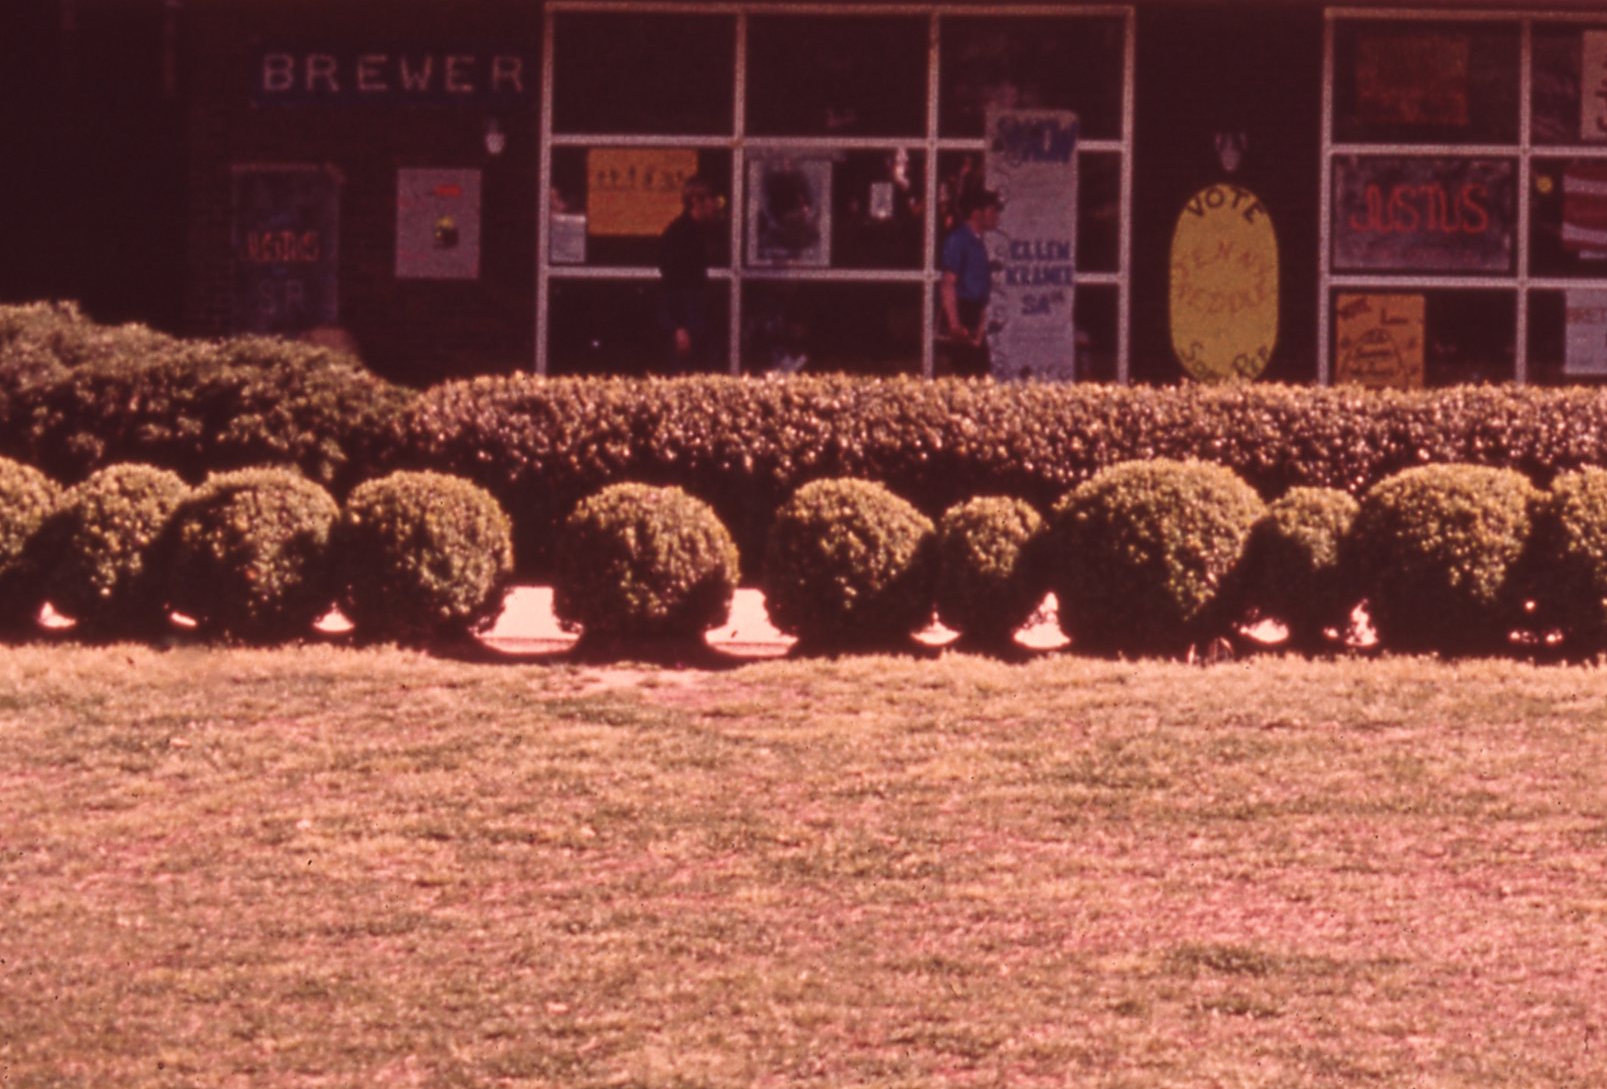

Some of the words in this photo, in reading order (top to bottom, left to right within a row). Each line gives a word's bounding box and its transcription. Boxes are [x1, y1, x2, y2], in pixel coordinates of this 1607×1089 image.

[259, 51, 526, 96] BREWER
[1185, 185, 1266, 224] VOTE
[1347, 179, 1491, 236] JUSTUS
